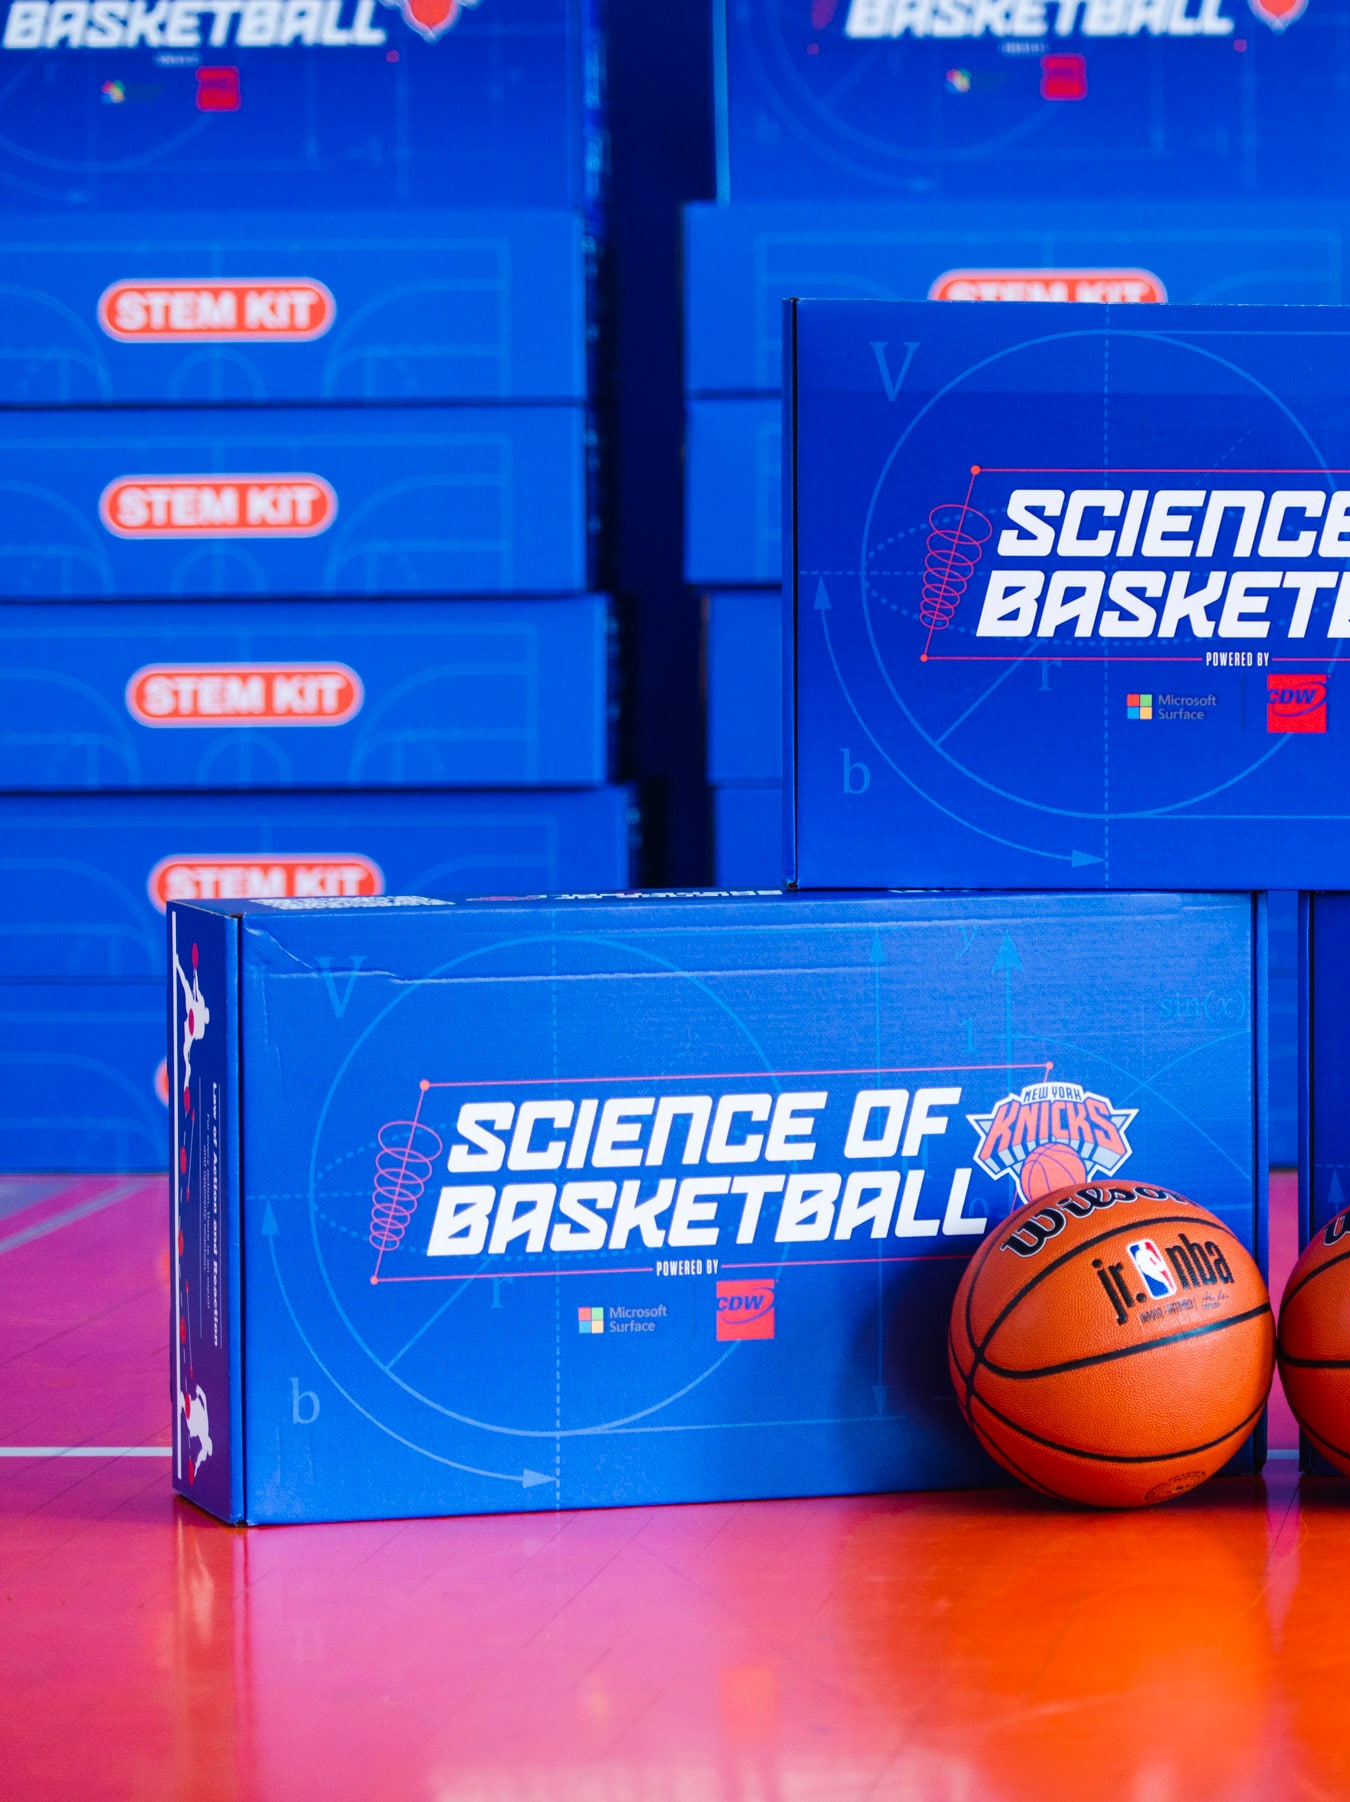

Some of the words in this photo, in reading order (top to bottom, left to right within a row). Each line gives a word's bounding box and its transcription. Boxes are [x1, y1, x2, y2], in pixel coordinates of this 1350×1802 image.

[3, 0, 387, 48] BASKETBALL
[845, 0, 1235, 37] BASKETBALL
[116, 290, 237, 330] STEM
[245, 290, 319, 329] KIT
[869, 341, 921, 402] V
[117, 486, 239, 526] STEM
[247, 485, 321, 525] KIT
[1206, 652, 1253, 667] POWERED
[1257, 652, 1270, 667] BY
[144, 676, 265, 715] STEM
[273, 675, 347, 714] KIT
[1158, 694, 1216, 706] Microsoft
[1158, 708, 1204, 720] Surface
[1268, 689, 1316, 705] CDW
[840, 748, 871, 794] b
[166, 867, 286, 899] STEM
[294, 866, 368, 897] KIT
[315, 955, 368, 1020] V
[1023, 1087, 1049, 1103] NEW
[1050, 1085, 1082, 1101] YORK
[212, 1125, 218, 1147] of
[446, 1090, 829, 1173] SCIENCE
[844, 1087, 963, 1159] OF
[979, 1098, 1126, 1161] KNICKS
[426, 1168, 988, 1257] BASKETBALL
[656, 1260, 702, 1277] POWERED
[706, 1259, 719, 1275] BY
[1091, 1258, 1146, 1326] jr.
[1165, 1233, 1235, 1290] nba
[609, 1304, 667, 1319] Microsoft
[717, 1295, 765, 1312] CDW
[609, 1320, 655, 1334] Surface
[291, 1378, 320, 1424] b
